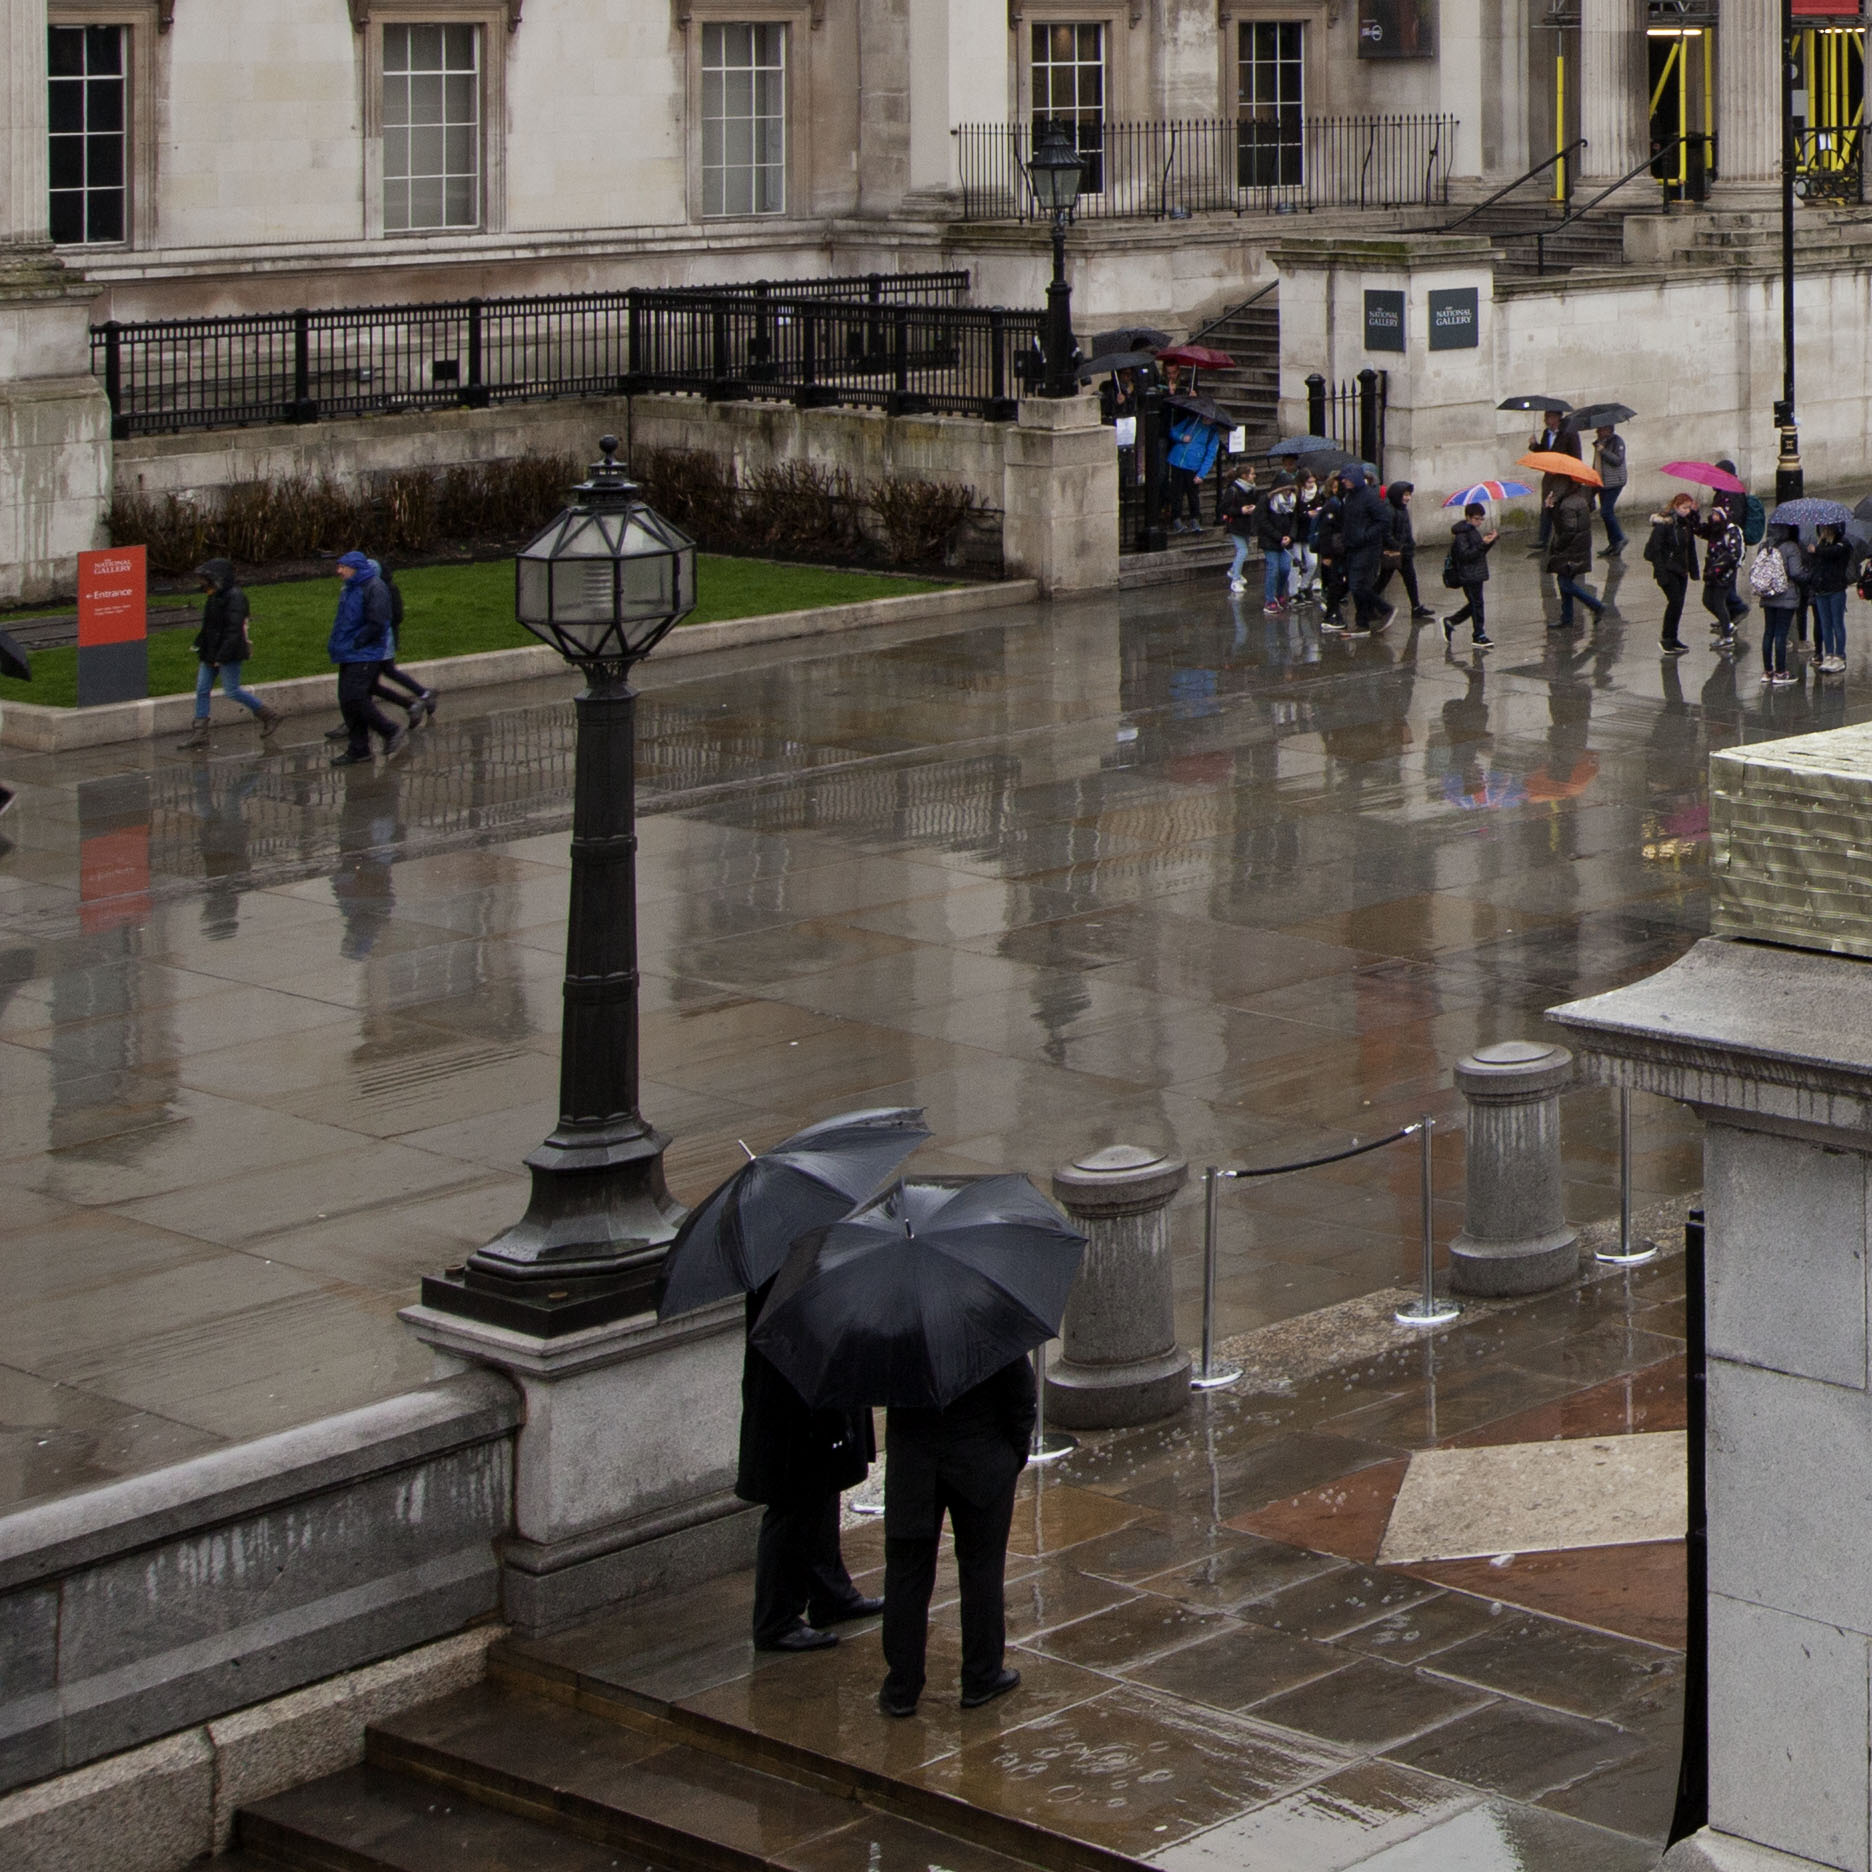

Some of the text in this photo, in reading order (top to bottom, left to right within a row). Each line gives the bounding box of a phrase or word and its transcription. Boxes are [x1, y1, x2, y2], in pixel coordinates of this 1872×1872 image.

[1369, 311, 1398, 319] NATIONAL
[1436, 309, 1473, 318] NATIONAL
[1368, 318, 1398, 327] GALLERY
[1435, 316, 1473, 327] GALLERY
[93, 588, 133, 599] Entrance
